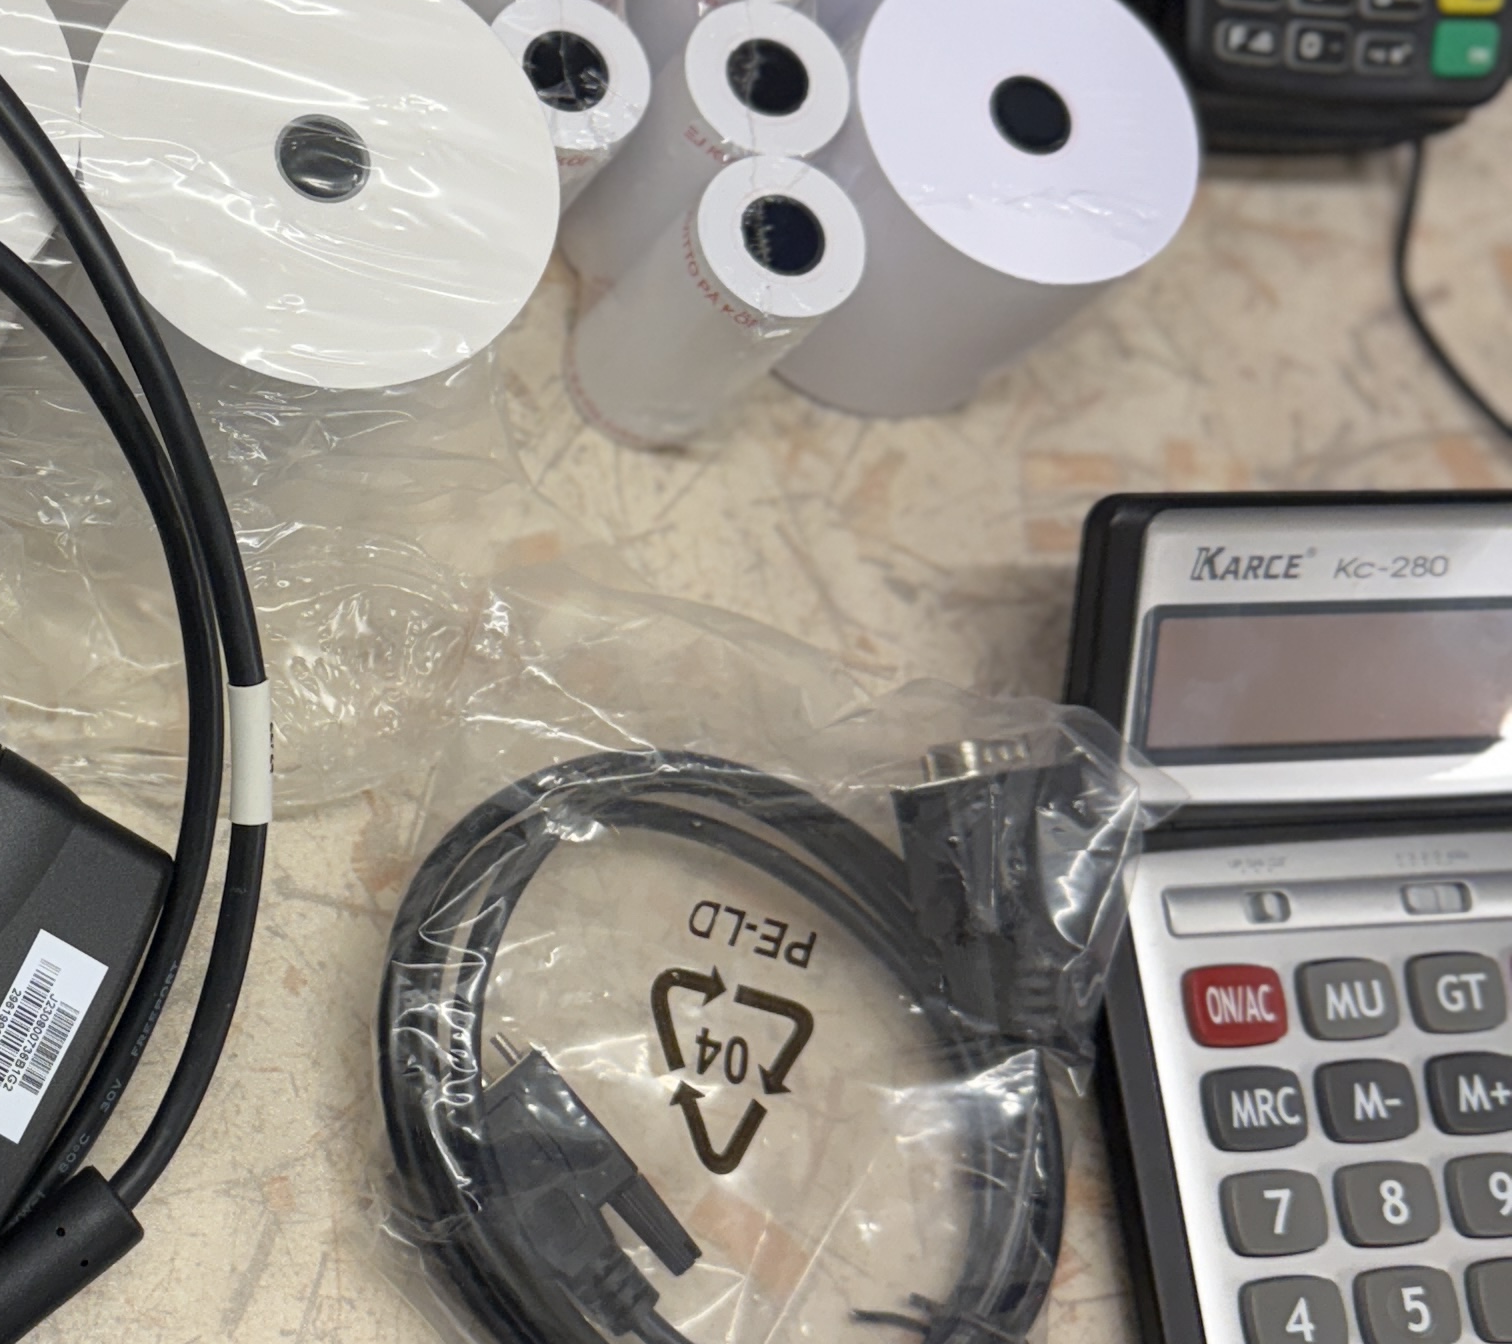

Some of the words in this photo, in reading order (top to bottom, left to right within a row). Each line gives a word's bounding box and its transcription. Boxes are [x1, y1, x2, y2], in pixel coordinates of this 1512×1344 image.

[688, 900, 818, 968] PE-LD
[1206, 984, 1276, 1024] ON/AC
[1326, 979, 1385, 1022] MU
[1436, 971, 1487, 1013] GT
[99, 1078, 123, 1113] 30V
[130, 959, 179, 1057] FREEPORT
[695, 1027, 749, 1084] 04
[1231, 1086, 1301, 1129] MRC
[1353, 1081, 1401, 1122] M-
[1263, 1188, 1293, 1235] 7
[1378, 1179, 1410, 1226] 8
[1488, 1171, 1512, 1216] 9
[1286, 1297, 1315, 1343] 4
[1402, 1286, 1431, 1333] 5
